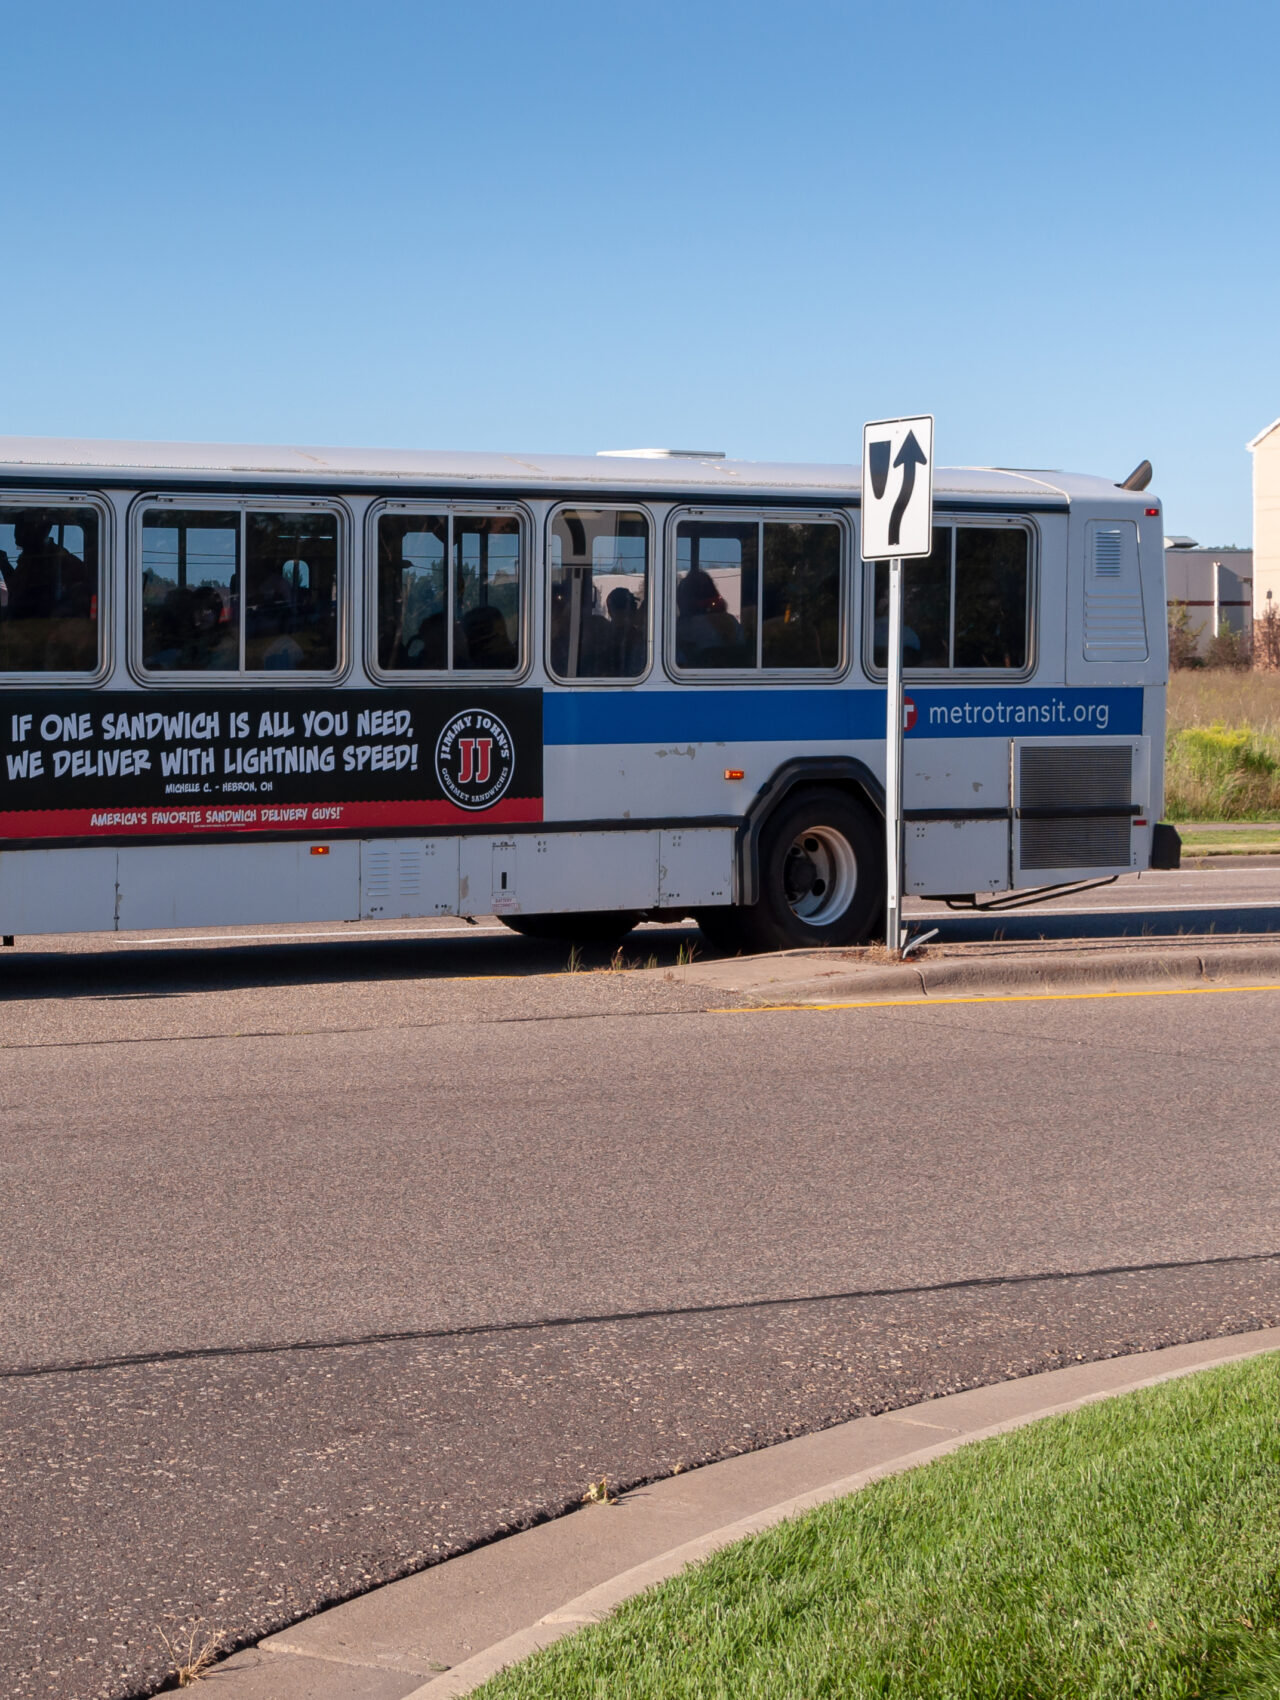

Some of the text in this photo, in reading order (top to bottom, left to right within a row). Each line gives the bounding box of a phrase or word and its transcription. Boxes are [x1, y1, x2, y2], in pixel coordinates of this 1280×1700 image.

[11, 709, 414, 742] IF ONE SANDWICH IS ALL YOU NEED,
[929, 697, 1109, 729] metrotransit.org
[440, 715, 509, 760] JIMMY JOHN'S
[6, 743, 419, 781] WE DELIVER WITH LIGHTNING SPEED!
[458, 738, 493, 783] JJ
[165, 783, 200, 794] MICHELLE
[203, 782, 212, 793] C.
[222, 781, 258, 792] HEBRON,
[260, 781, 273, 792] OH
[442, 766, 509, 802] GOURMET SANDWICHES
[90, 812, 147, 827] AMERICA'S
[151, 811, 202, 825] FAVORITE
[205, 809, 257, 824] SANDWICH
[261, 807, 308, 822] DELIVERY
